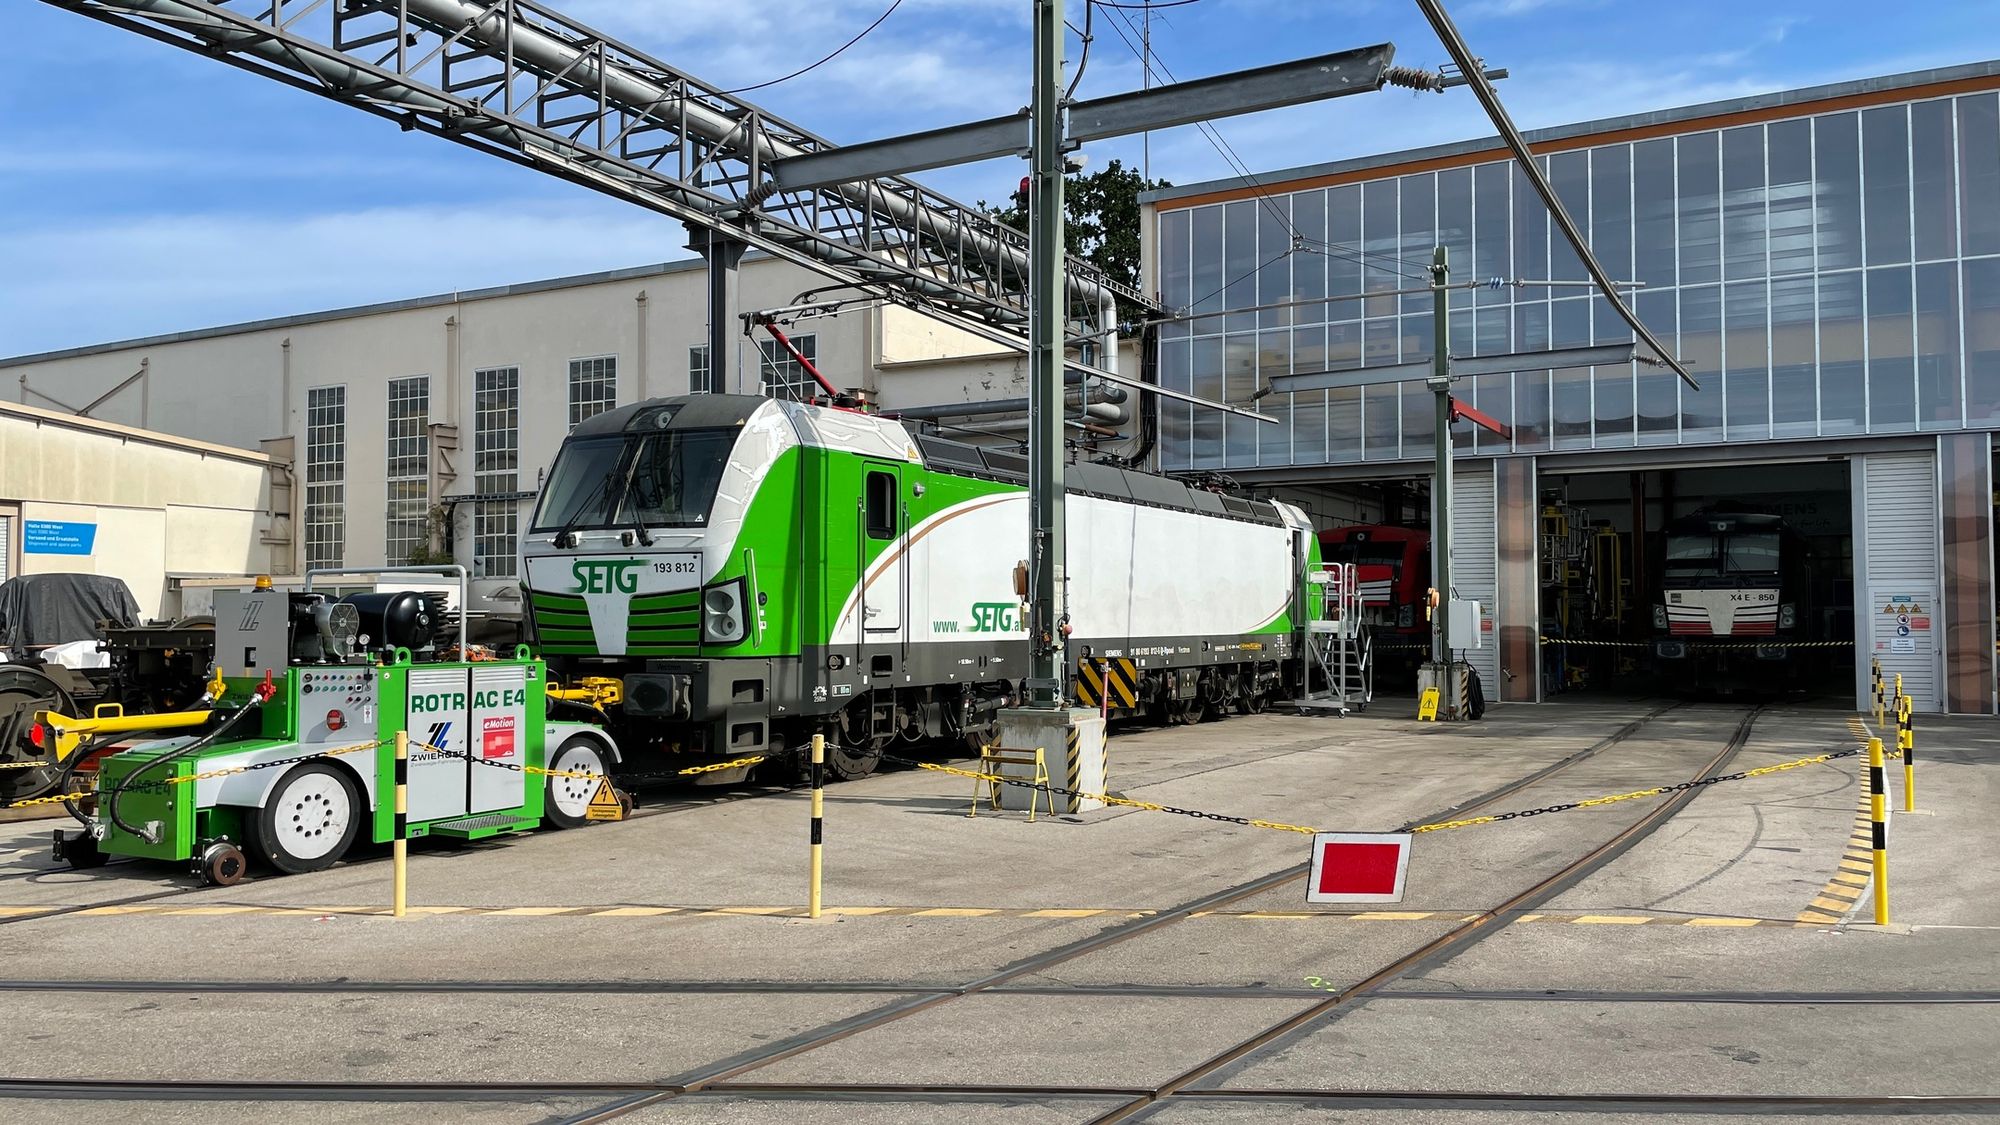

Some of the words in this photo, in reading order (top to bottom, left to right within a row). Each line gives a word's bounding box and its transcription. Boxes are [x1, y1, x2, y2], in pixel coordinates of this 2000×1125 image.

[654, 563, 672, 573] 193
[675, 562, 695, 573] 812
[565, 560, 648, 594] SETG
[503, 689, 525, 707] E4
[484, 718, 514, 730] eMotion
